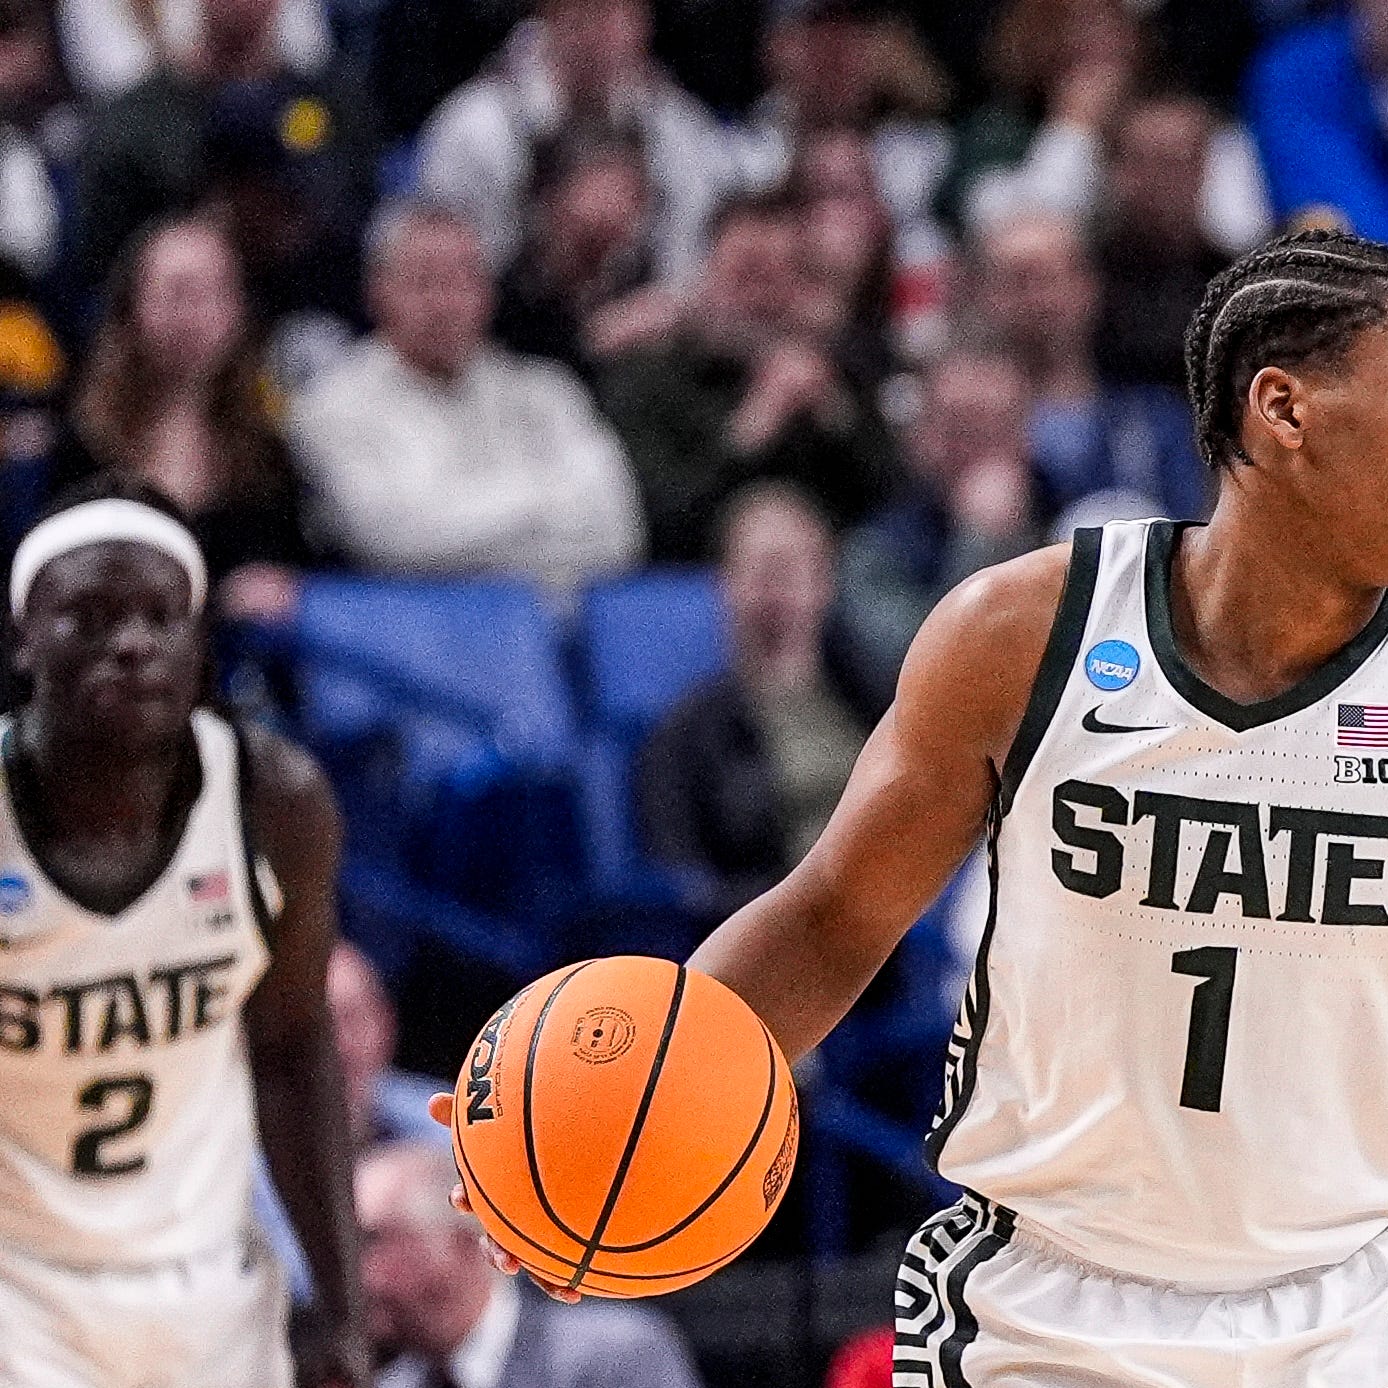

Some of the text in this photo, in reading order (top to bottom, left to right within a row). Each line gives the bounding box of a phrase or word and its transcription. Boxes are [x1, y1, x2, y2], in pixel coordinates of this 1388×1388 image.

[1091, 659, 1136, 680] NCAA
[0, 952, 240, 1054] STATE
[1171, 945, 1239, 1113] 1
[73, 1072, 154, 1181] 2
